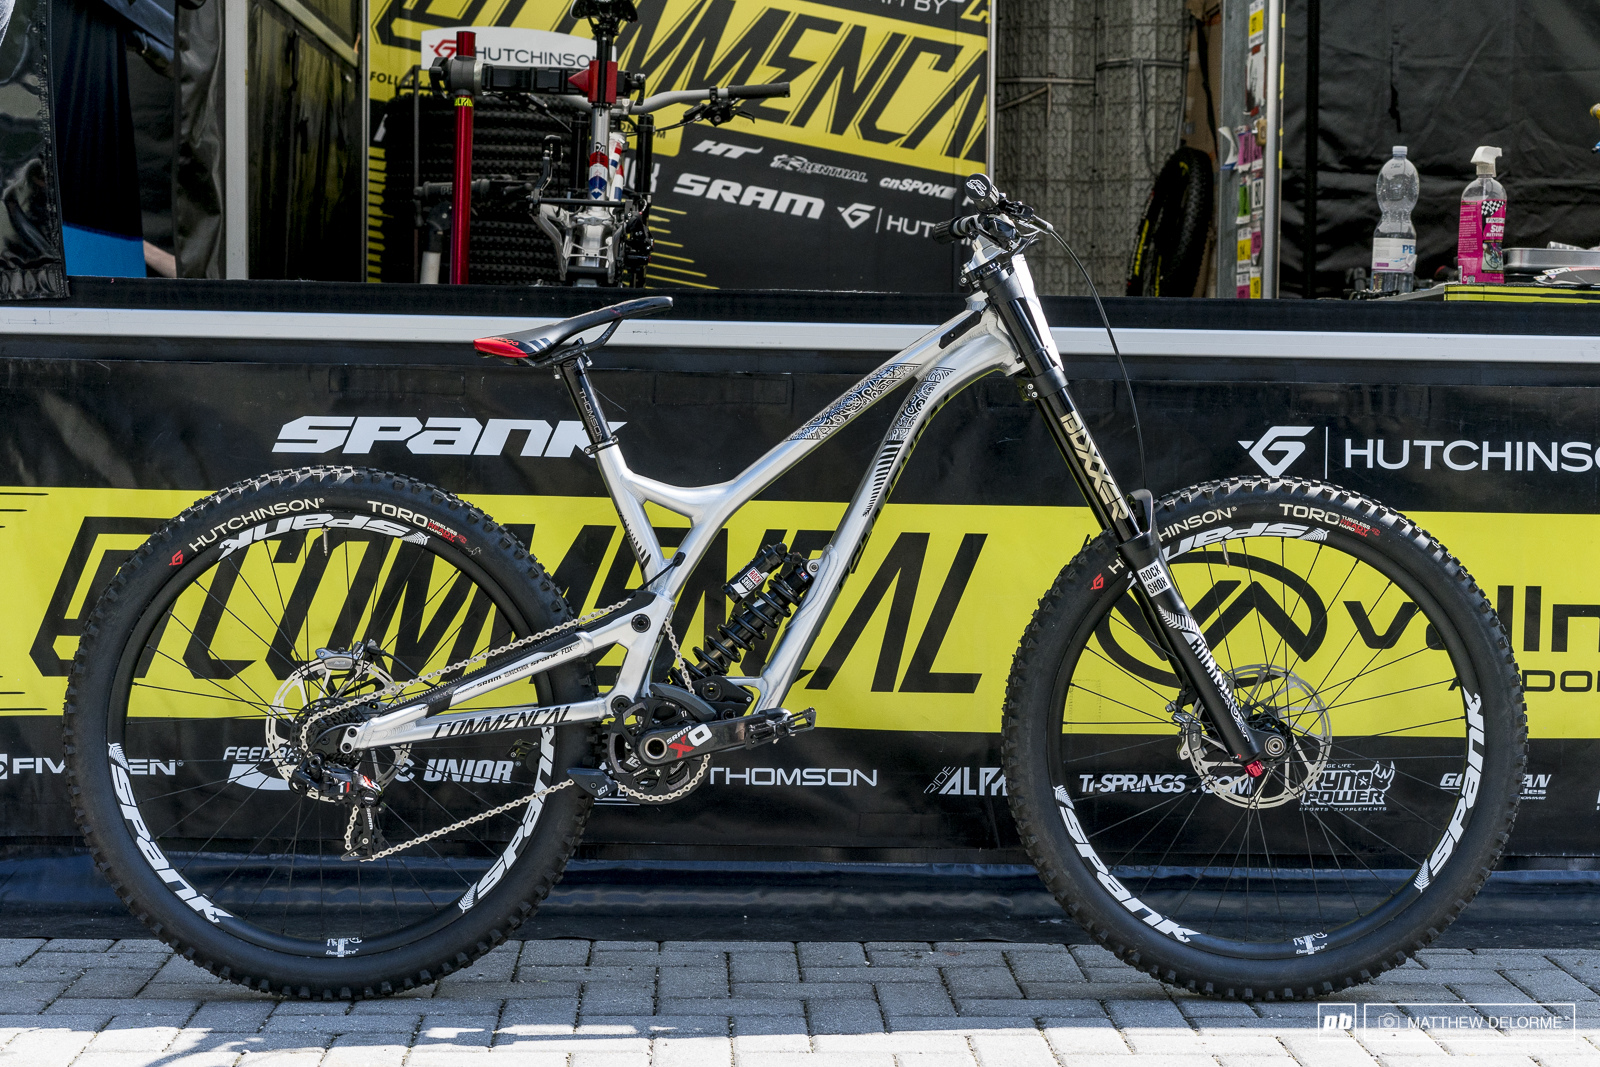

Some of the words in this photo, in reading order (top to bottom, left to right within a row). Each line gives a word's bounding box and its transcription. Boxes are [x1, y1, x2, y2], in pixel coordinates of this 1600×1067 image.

[475, 45, 598, 69] HUTCHINSO
[692, 139, 763, 159] HT
[673, 172, 825, 220] SRAM
[1345, 438, 1600, 472] HUTCHINS
[367, 500, 429, 528] TORO
[1279, 503, 1341, 526] TORO
[1140, 563, 1162, 583] ROCK
[1147, 576, 1169, 595] SHOX
[432, 705, 573, 739] COMMENCAL
[666, 725, 692, 745] SRAM
[12, 757, 66, 775] FIV
[709, 766, 878, 788] THOMSON
[923, 766, 956, 794] RIDE
[1301, 790, 1385, 806] POWER
